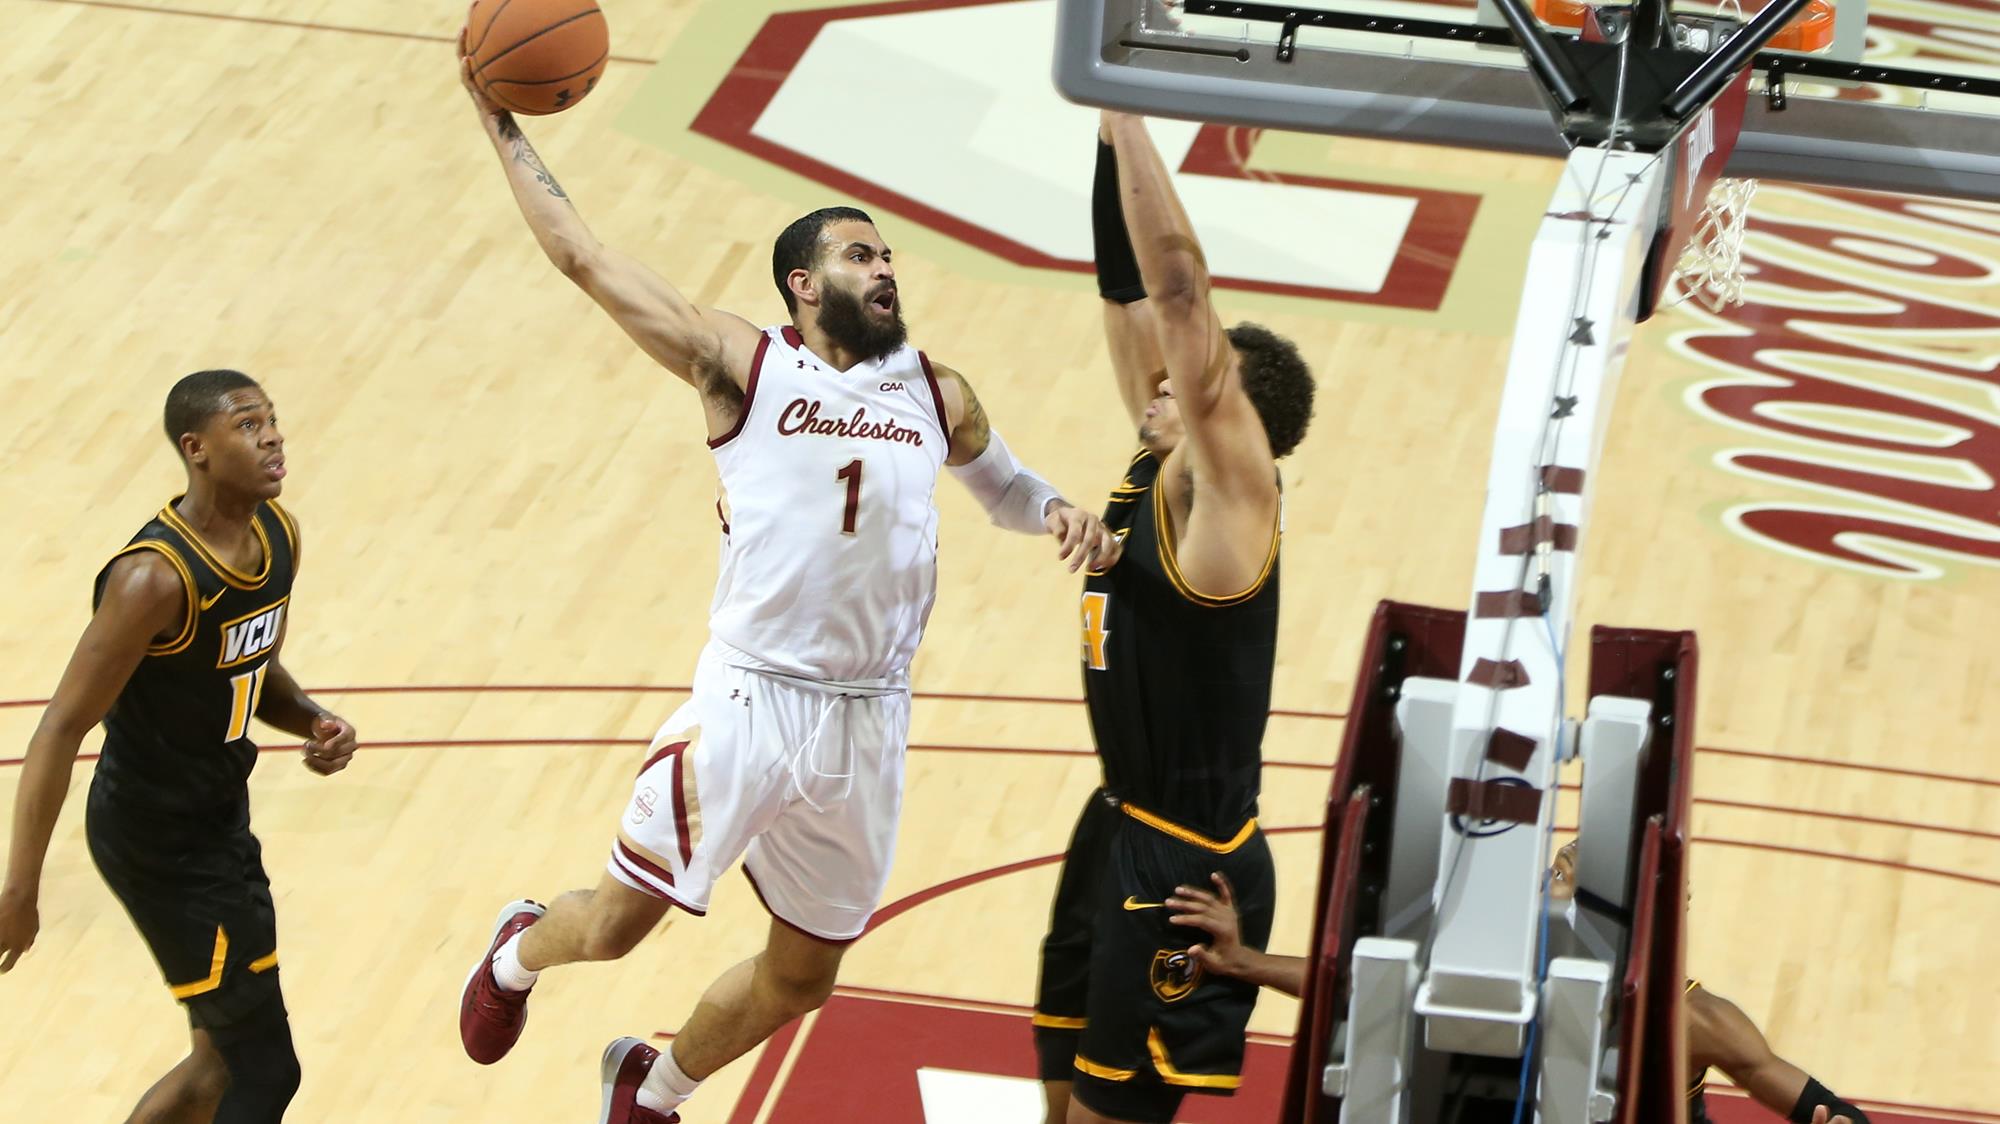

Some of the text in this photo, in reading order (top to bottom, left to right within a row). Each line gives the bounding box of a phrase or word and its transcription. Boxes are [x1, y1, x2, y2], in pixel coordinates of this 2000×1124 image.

[879, 381, 905, 392] CAA
[777, 397, 923, 447] Charleston
[835, 457, 864, 536] 1
[222, 603, 286, 664] VCU
